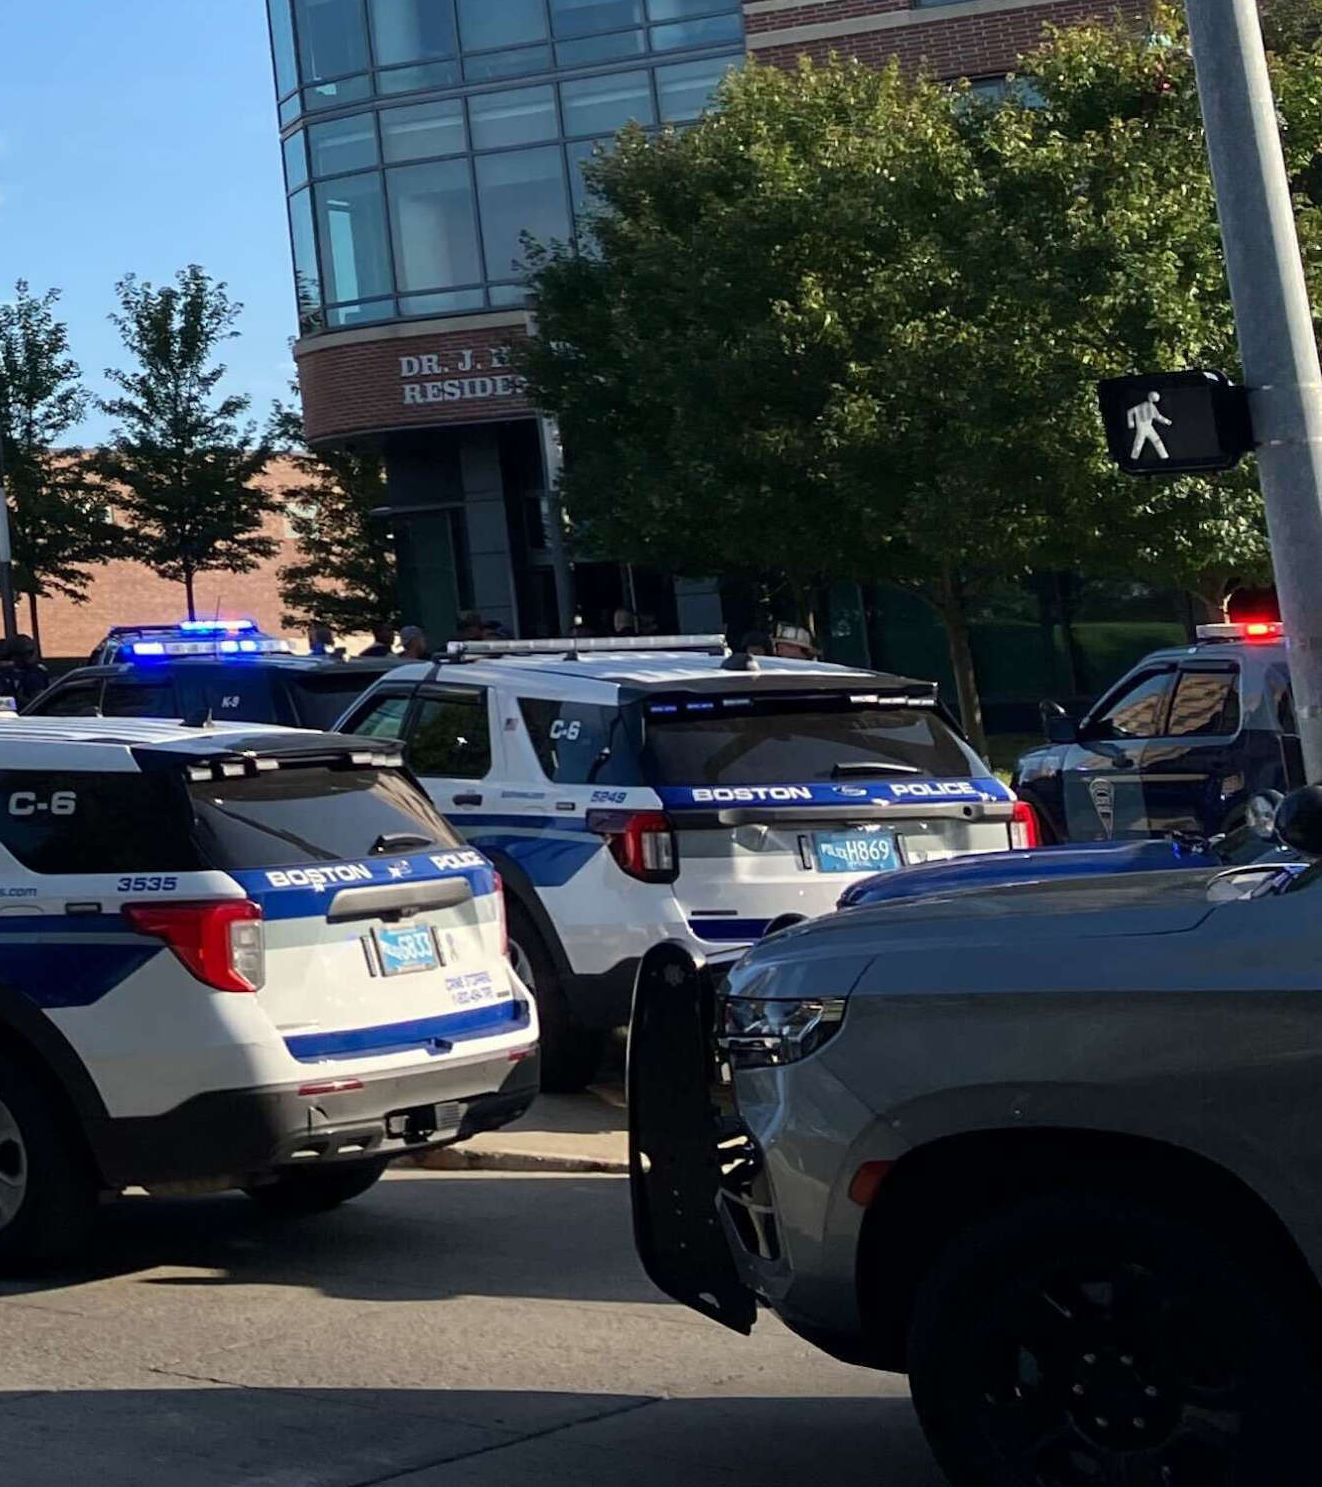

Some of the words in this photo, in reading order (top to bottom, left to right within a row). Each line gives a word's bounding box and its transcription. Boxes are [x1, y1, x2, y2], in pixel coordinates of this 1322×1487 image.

[398, 354, 449, 378] DR.
[458, 349, 482, 372] J.
[549, 719, 581, 740] C-6
[692, 786, 813, 802] BOSTON
[889, 781, 975, 797] POLICE
[8, 790, 77, 816] C-6
[845, 840, 890, 862] H869
[265, 863, 373, 888] BOSTON
[429, 851, 486, 871] POLICE
[117, 877, 178, 892] 3535
